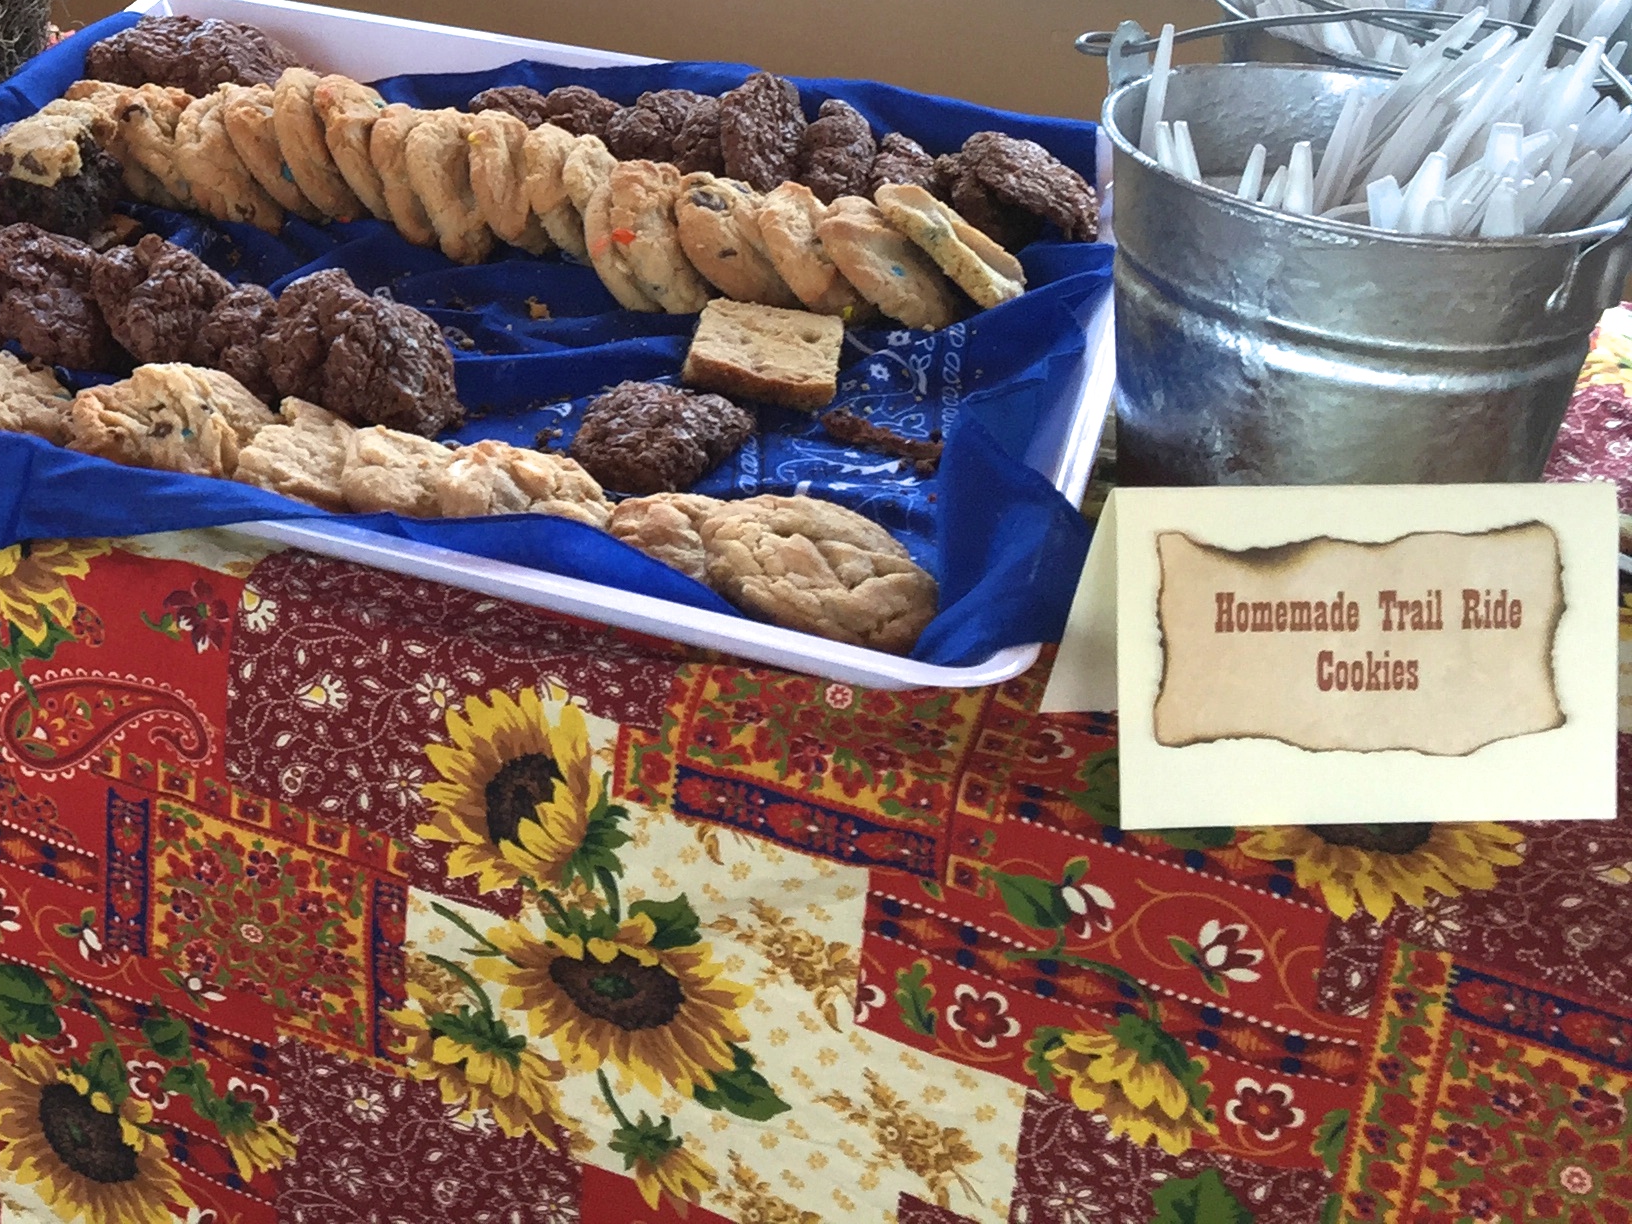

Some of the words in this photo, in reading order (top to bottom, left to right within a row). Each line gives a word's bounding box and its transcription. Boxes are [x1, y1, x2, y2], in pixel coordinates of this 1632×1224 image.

[1214, 591, 1360, 633] Homemade
[1378, 589, 1443, 631] Trail
[1461, 589, 1523, 630] Ride
[1317, 650, 1419, 691] Cookies
